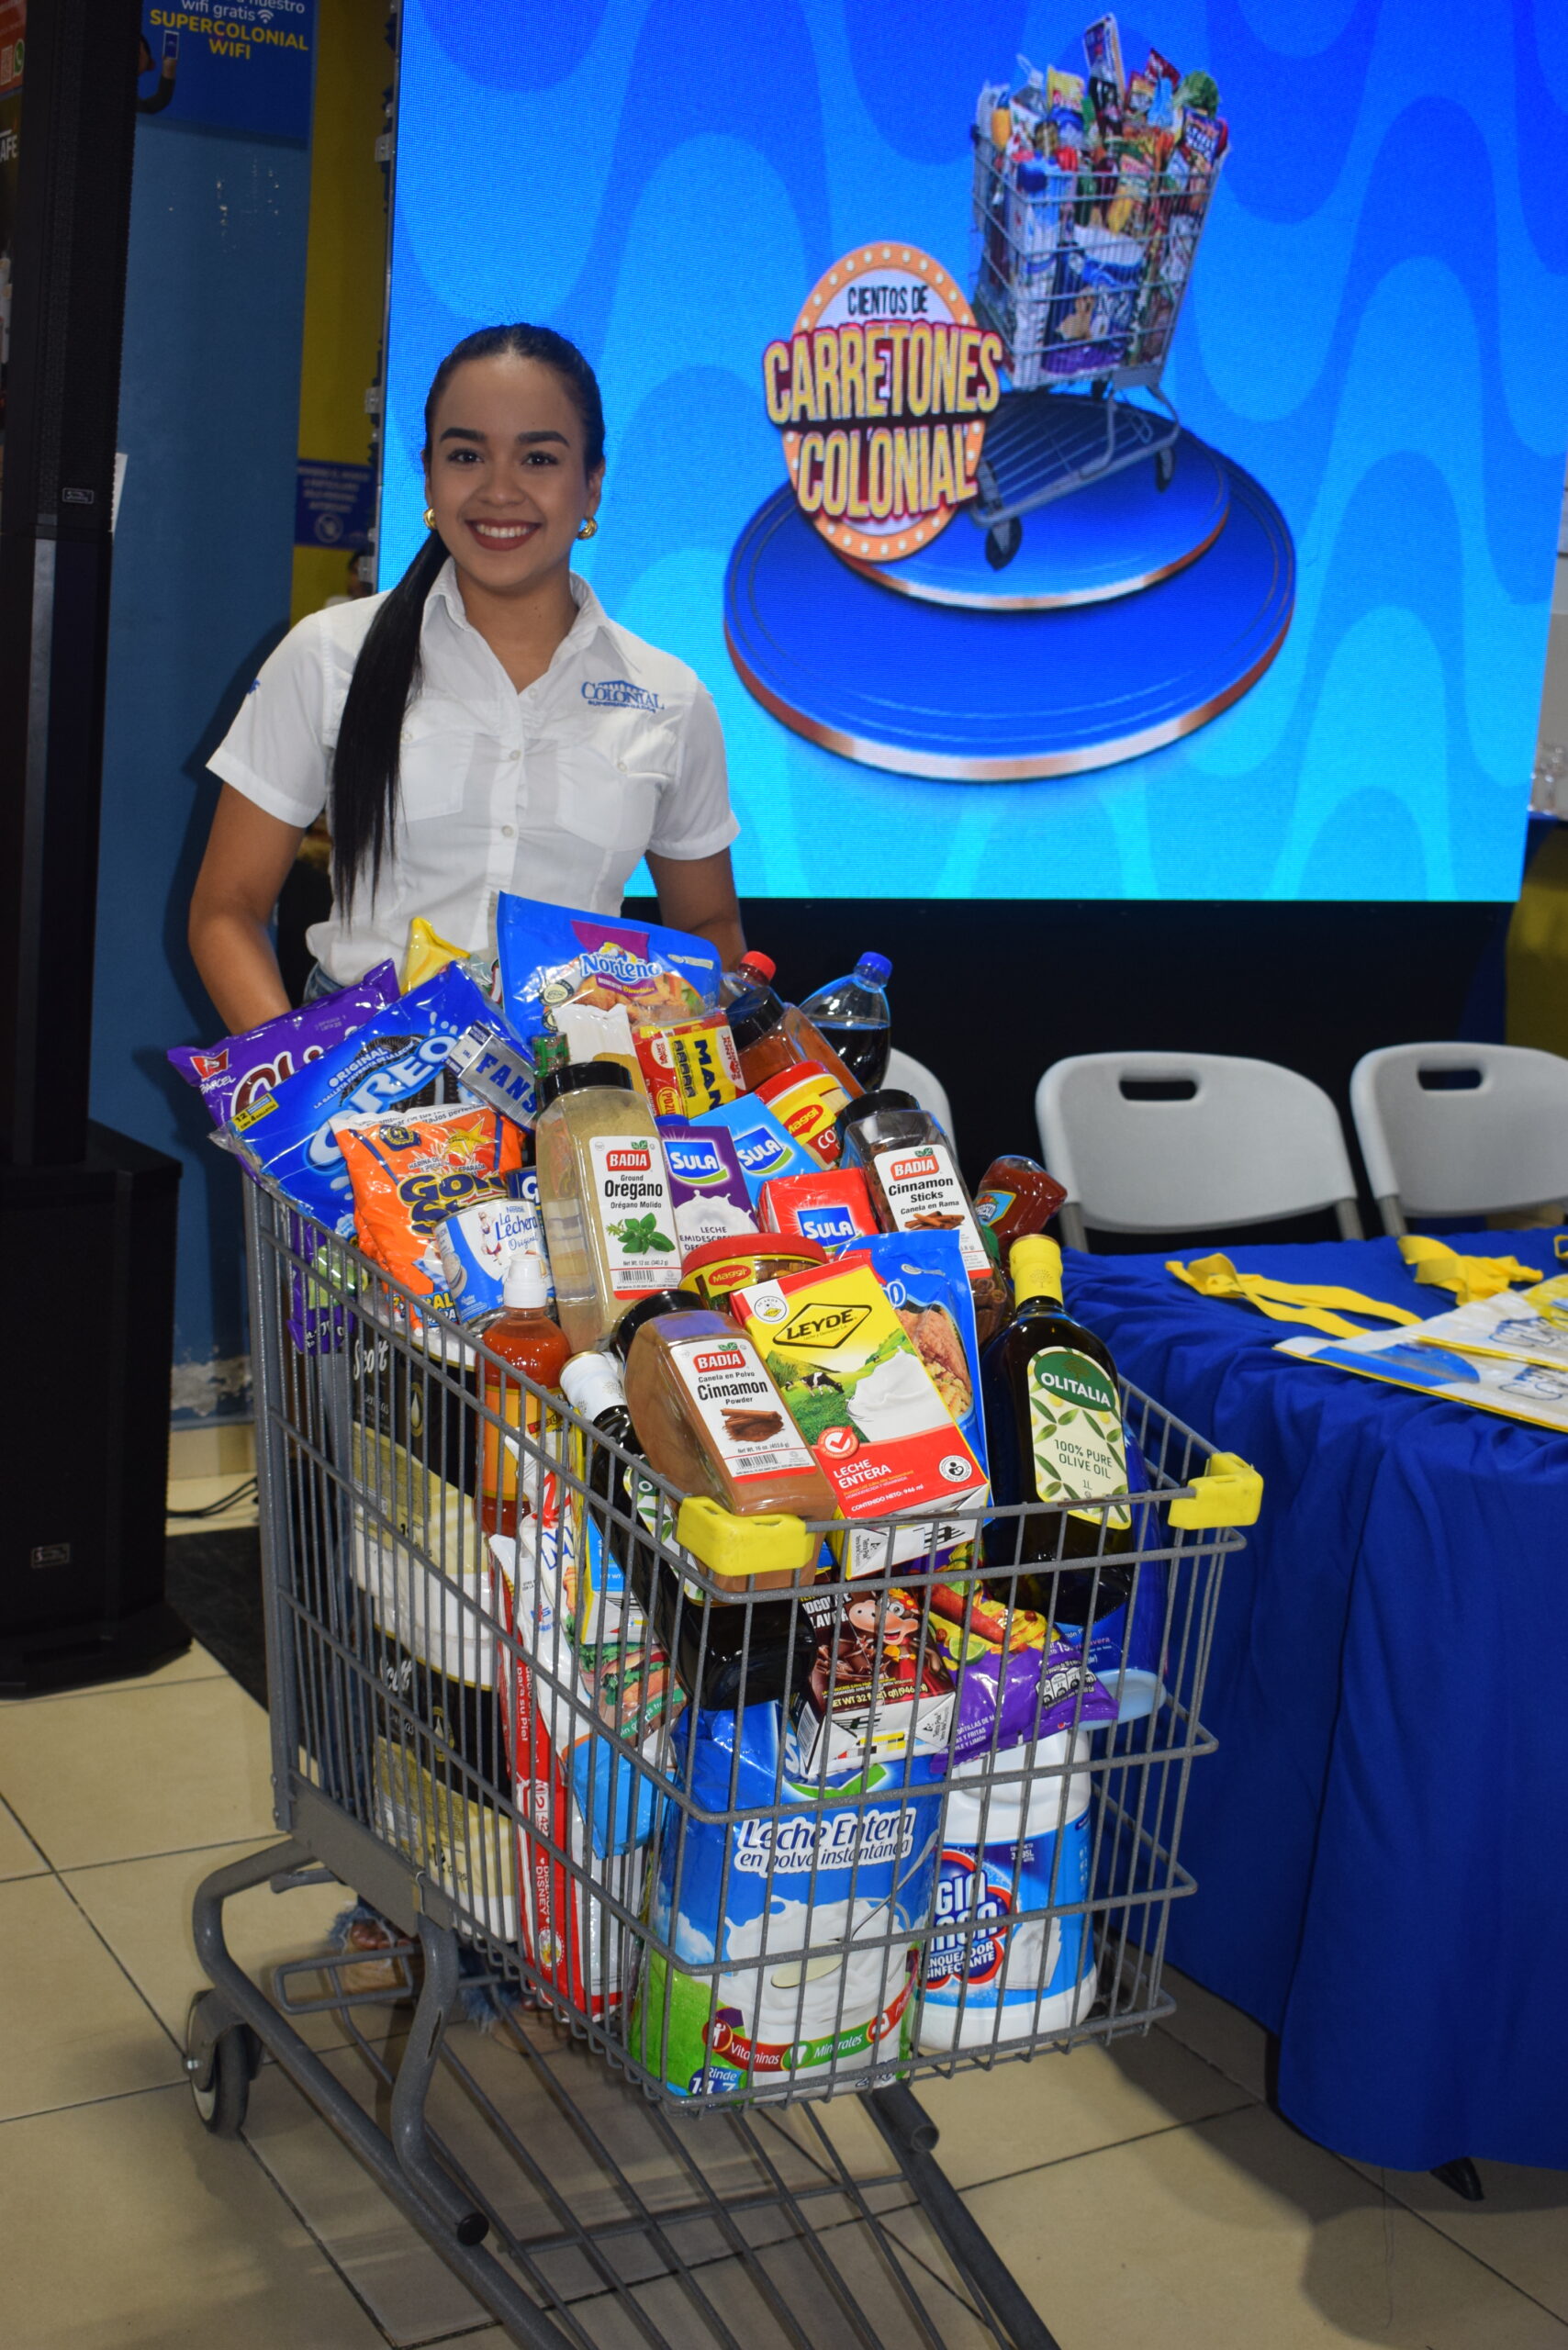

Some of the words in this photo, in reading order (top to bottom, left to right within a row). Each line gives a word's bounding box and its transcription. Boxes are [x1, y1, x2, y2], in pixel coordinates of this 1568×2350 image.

[182, 0, 209, 13] wifi
[213, 5, 256, 22] gratis
[150, 9, 309, 51] SUPERCOLONIAL
[208, 38, 251, 60] WIFI
[0, 135, 17, 163] AFE
[847, 285, 908, 316] CIENTOS
[912, 285, 928, 314] DE
[764, 322, 1002, 424] CARRETONES
[798, 423, 978, 518] COLONIAL
[329, 1046, 388, 1088] ORIGINAL
[322, 1080, 349, 1102] GALLETA
[476, 1053, 537, 1113] FANS
[309, 1035, 460, 1167] OREO
[662, 1092, 677, 1114] POZU
[235, 1112, 248, 1123] 12
[788, 1106, 820, 1134] Maggi
[610, 1153, 647, 1168] BADIA
[670, 1151, 718, 1169] SULA
[736, 1139, 781, 1167] SULA
[893, 1158, 935, 1178] BADIA
[605, 1180, 663, 1201] Oregano
[888, 1178, 954, 1197] Cinnamon
[910, 1191, 944, 1203] Sticks
[610, 1202, 638, 1210] Orégano
[640, 1201, 661, 1209] Molido
[901, 1204, 926, 1215] Canela
[939, 1200, 959, 1208] Rama
[496, 1215, 538, 1240] Lechera
[499, 1213, 511, 1226] La
[803, 1221, 854, 1240] SULA
[508, 1236, 539, 1251] Original
[712, 1269, 748, 1283] Maggi
[786, 1308, 854, 1340] LEYDE
[697, 1353, 742, 1370] BADIA
[698, 1374, 724, 1383] Canela
[1041, 1372, 1112, 1407] OLITALIA
[697, 1381, 769, 1401] Cinnamon
[725, 1396, 754, 1405] Powder
[1055, 1438, 1084, 1457] 100%
[1086, 1449, 1113, 1468] PURE
[833, 1459, 872, 1479] LECHE
[838, 1464, 892, 1489] ENTERA
[1058, 1453, 1092, 1472] OLIVE
[1093, 1463, 1111, 1479] OIL
[1082, 1479, 1092, 1491] 1L
[851, 1495, 886, 1512] CONTENIDO
[886, 1490, 903, 1501] NETO:
[903, 1487, 915, 1495] 946
[520, 1698, 526, 1715] su
[844, 1696, 857, 1706] WT
[857, 1693, 867, 1703] 32
[956, 1719, 982, 1734] ORTILLAS
[982, 1717, 990, 1726] DE
[969, 1727, 986, 1739] FRITAS
[969, 1734, 987, 1746] LIMÓN
[743, 1821, 825, 1851] Leche
[833, 1814, 913, 1847] Entera
[740, 1852, 762, 1867] en
[765, 1852, 815, 1873] polvo
[820, 1839, 910, 1865] instantánea
[536, 1865, 547, 1915] DISNEY
[927, 1952, 995, 1978] SINFECTANTE
[731, 2042, 779, 2065] Vitaminas
[813, 2033, 863, 2059] Minerales
[709, 2066, 738, 2082] Rinde
